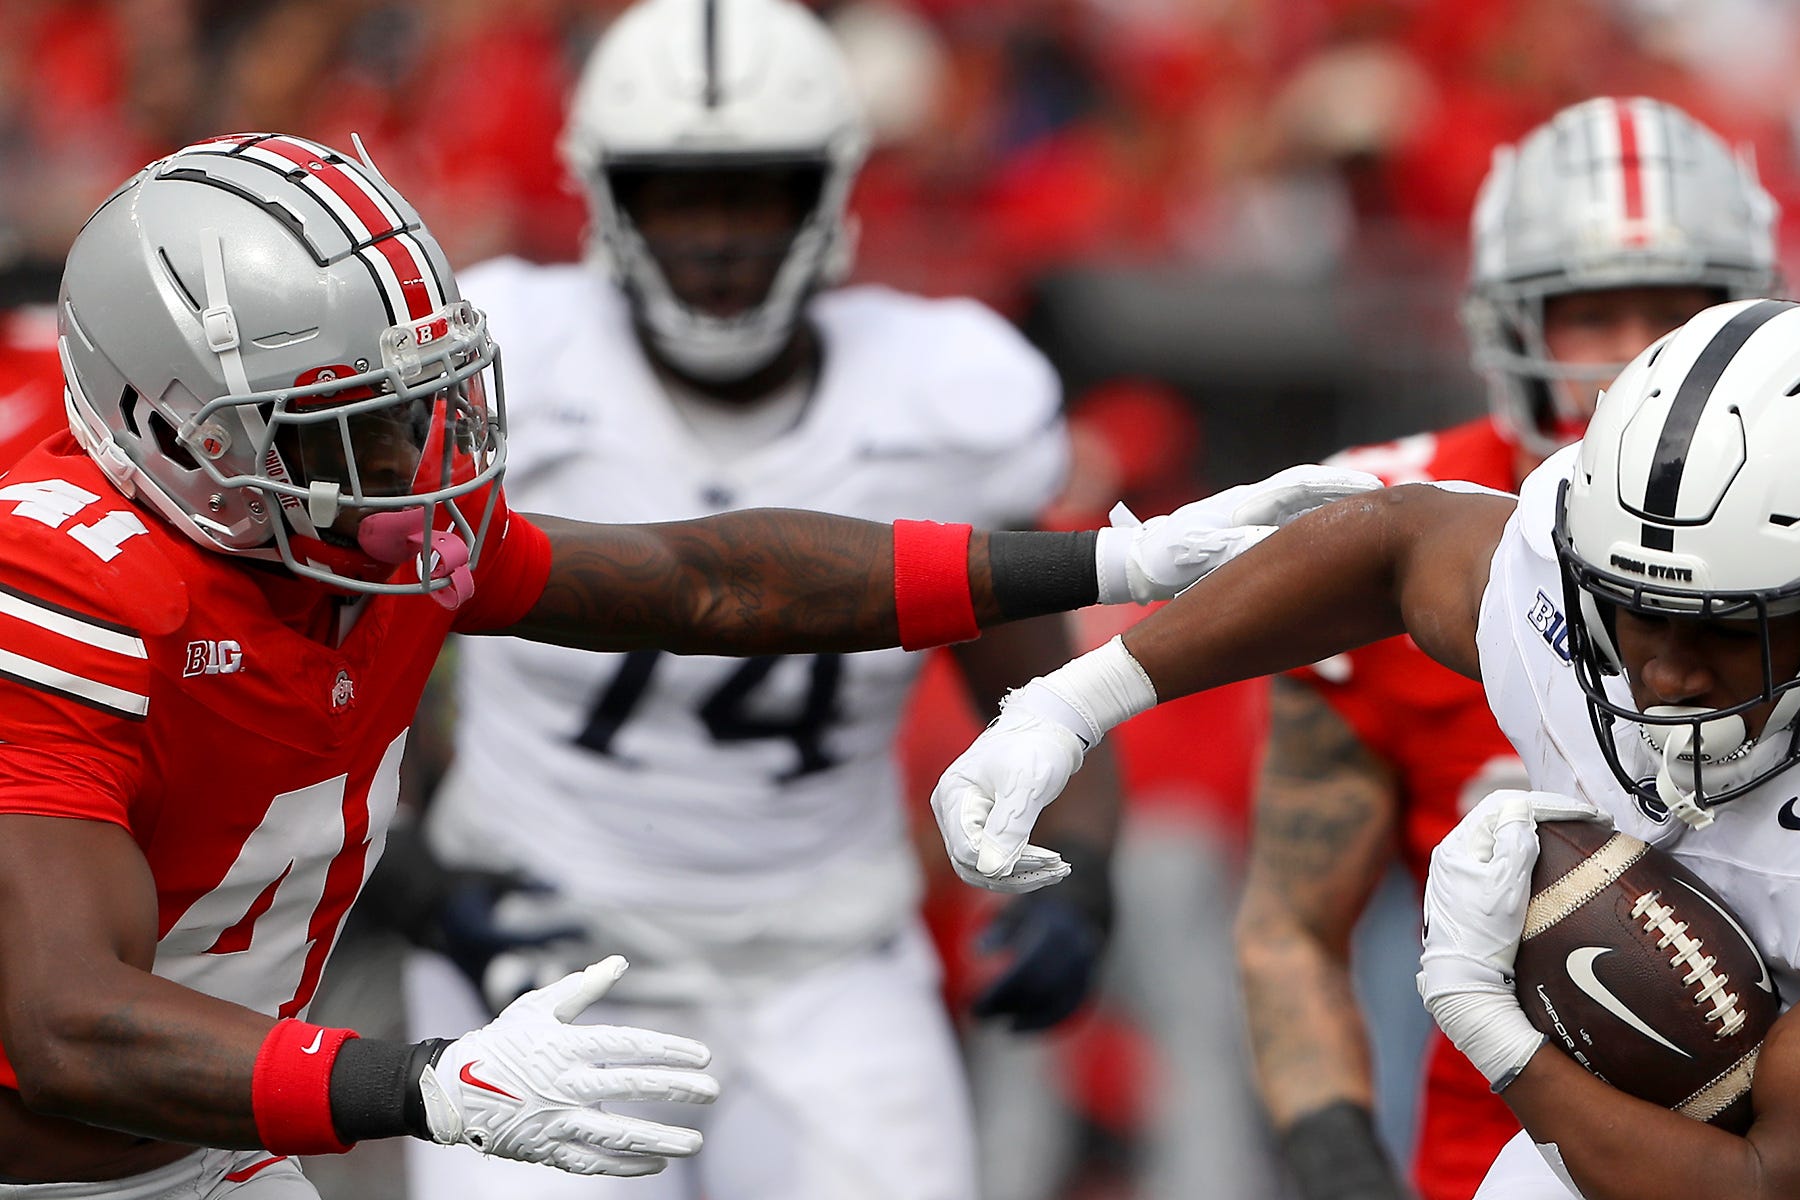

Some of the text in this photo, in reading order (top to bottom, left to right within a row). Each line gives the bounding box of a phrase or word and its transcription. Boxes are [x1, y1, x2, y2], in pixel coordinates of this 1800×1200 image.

[0, 478, 150, 563] 41
[1610, 554, 1693, 583] PENN STATE
[1536, 984, 1575, 1049] VAPOR
